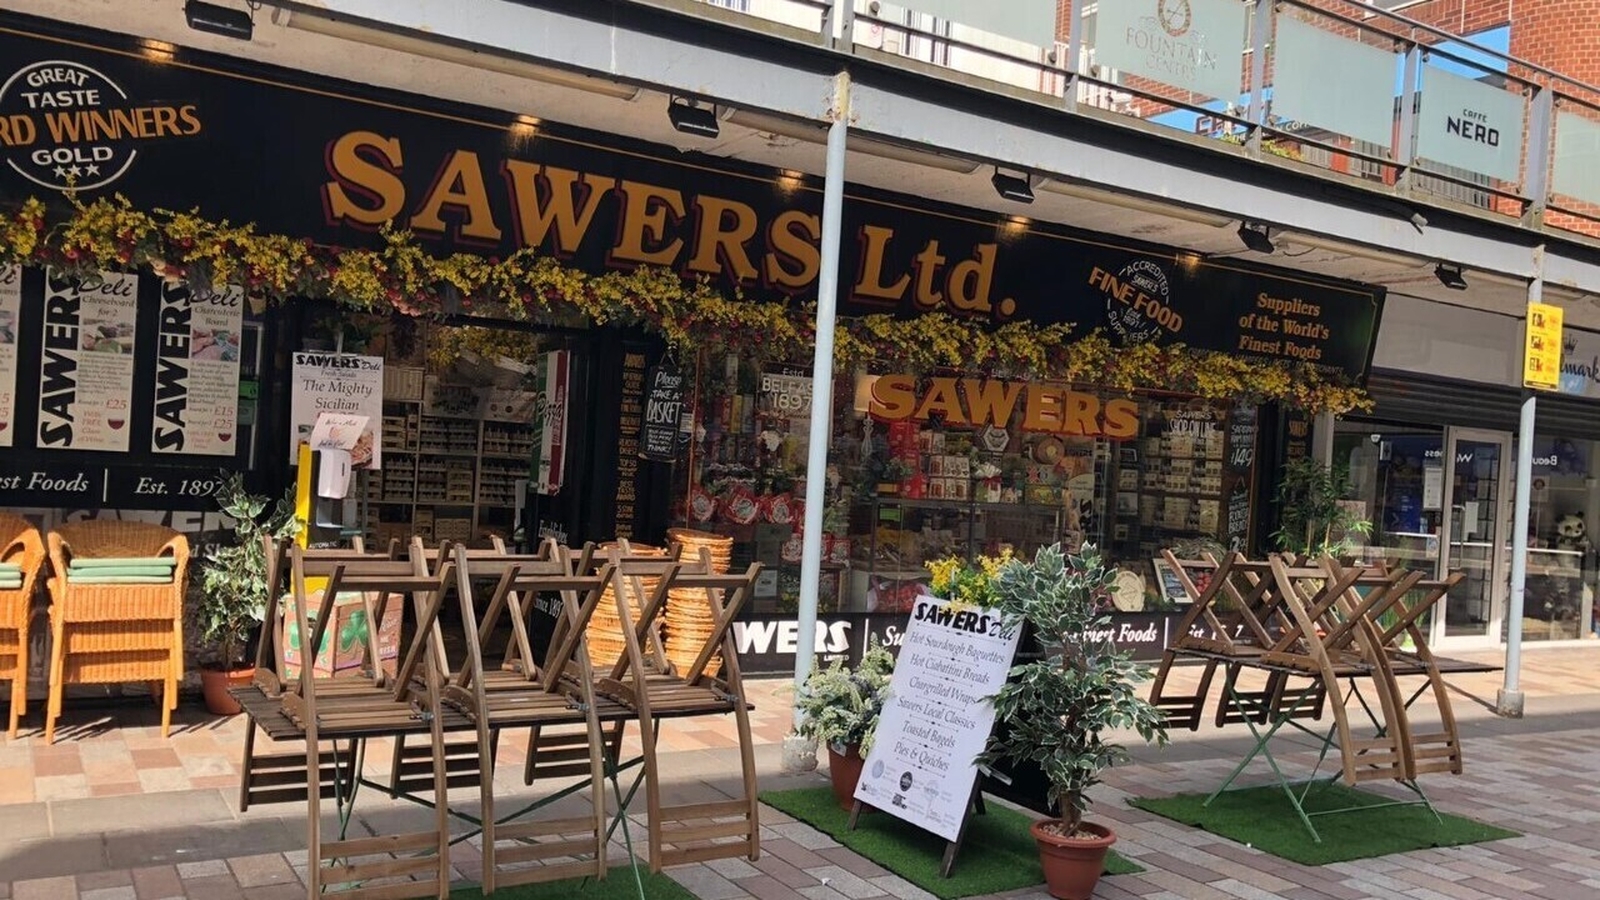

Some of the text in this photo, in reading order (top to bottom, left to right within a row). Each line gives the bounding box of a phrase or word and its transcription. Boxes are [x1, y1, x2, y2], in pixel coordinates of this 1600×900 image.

[27, 68, 89, 88] GREAT
[21, 90, 101, 109] TASTE
[45, 105, 201, 144] WINNERS
[1446, 116, 1500, 147] NERO
[32, 147, 114, 166] GOLD
[320, 131, 1016, 319] SAWERS Ltd.
[79, 274, 133, 297] Deli
[1126, 260, 1169, 296] ACCREDITED
[1088, 266, 1183, 333] FINE FOOD
[1257, 292, 1321, 316] Suppliers
[1239, 313, 1330, 340] of the World's
[1238, 335, 1322, 360] Finest Foods
[296, 355, 381, 371] SAWERS Deli
[304, 379, 372, 398] The Mighty
[655, 371, 682, 387] Please
[106, 399, 127, 410] £25
[315, 397, 360, 411] Sicilian
[653, 389, 671, 399] TAKE
[773, 394, 812, 411] 1897
[647, 399, 682, 424] BASKET
[867, 374, 1139, 441] SAWERS
[1175, 410, 1212, 420] SAWERS
[26, 472, 90, 492] Foods
[134, 478, 170, 495] Est.
[915, 603, 991, 634] SAWERS
[1117, 624, 1157, 643] Foods
[910, 632, 925, 645] Hot
[925, 636, 966, 657] Sourdough
[966, 644, 1006, 664] Baguettes
[910, 653, 925, 666] Hot
[963, 667, 991, 684] Breads
[909, 676, 951, 698] Chargrilled
[923, 703, 946, 719] Local
[944, 710, 976, 730] Classics
[902, 720, 956, 749] Toasted Bagels
[894, 741, 909, 757] Pies
[918, 750, 950, 772] Quiches
